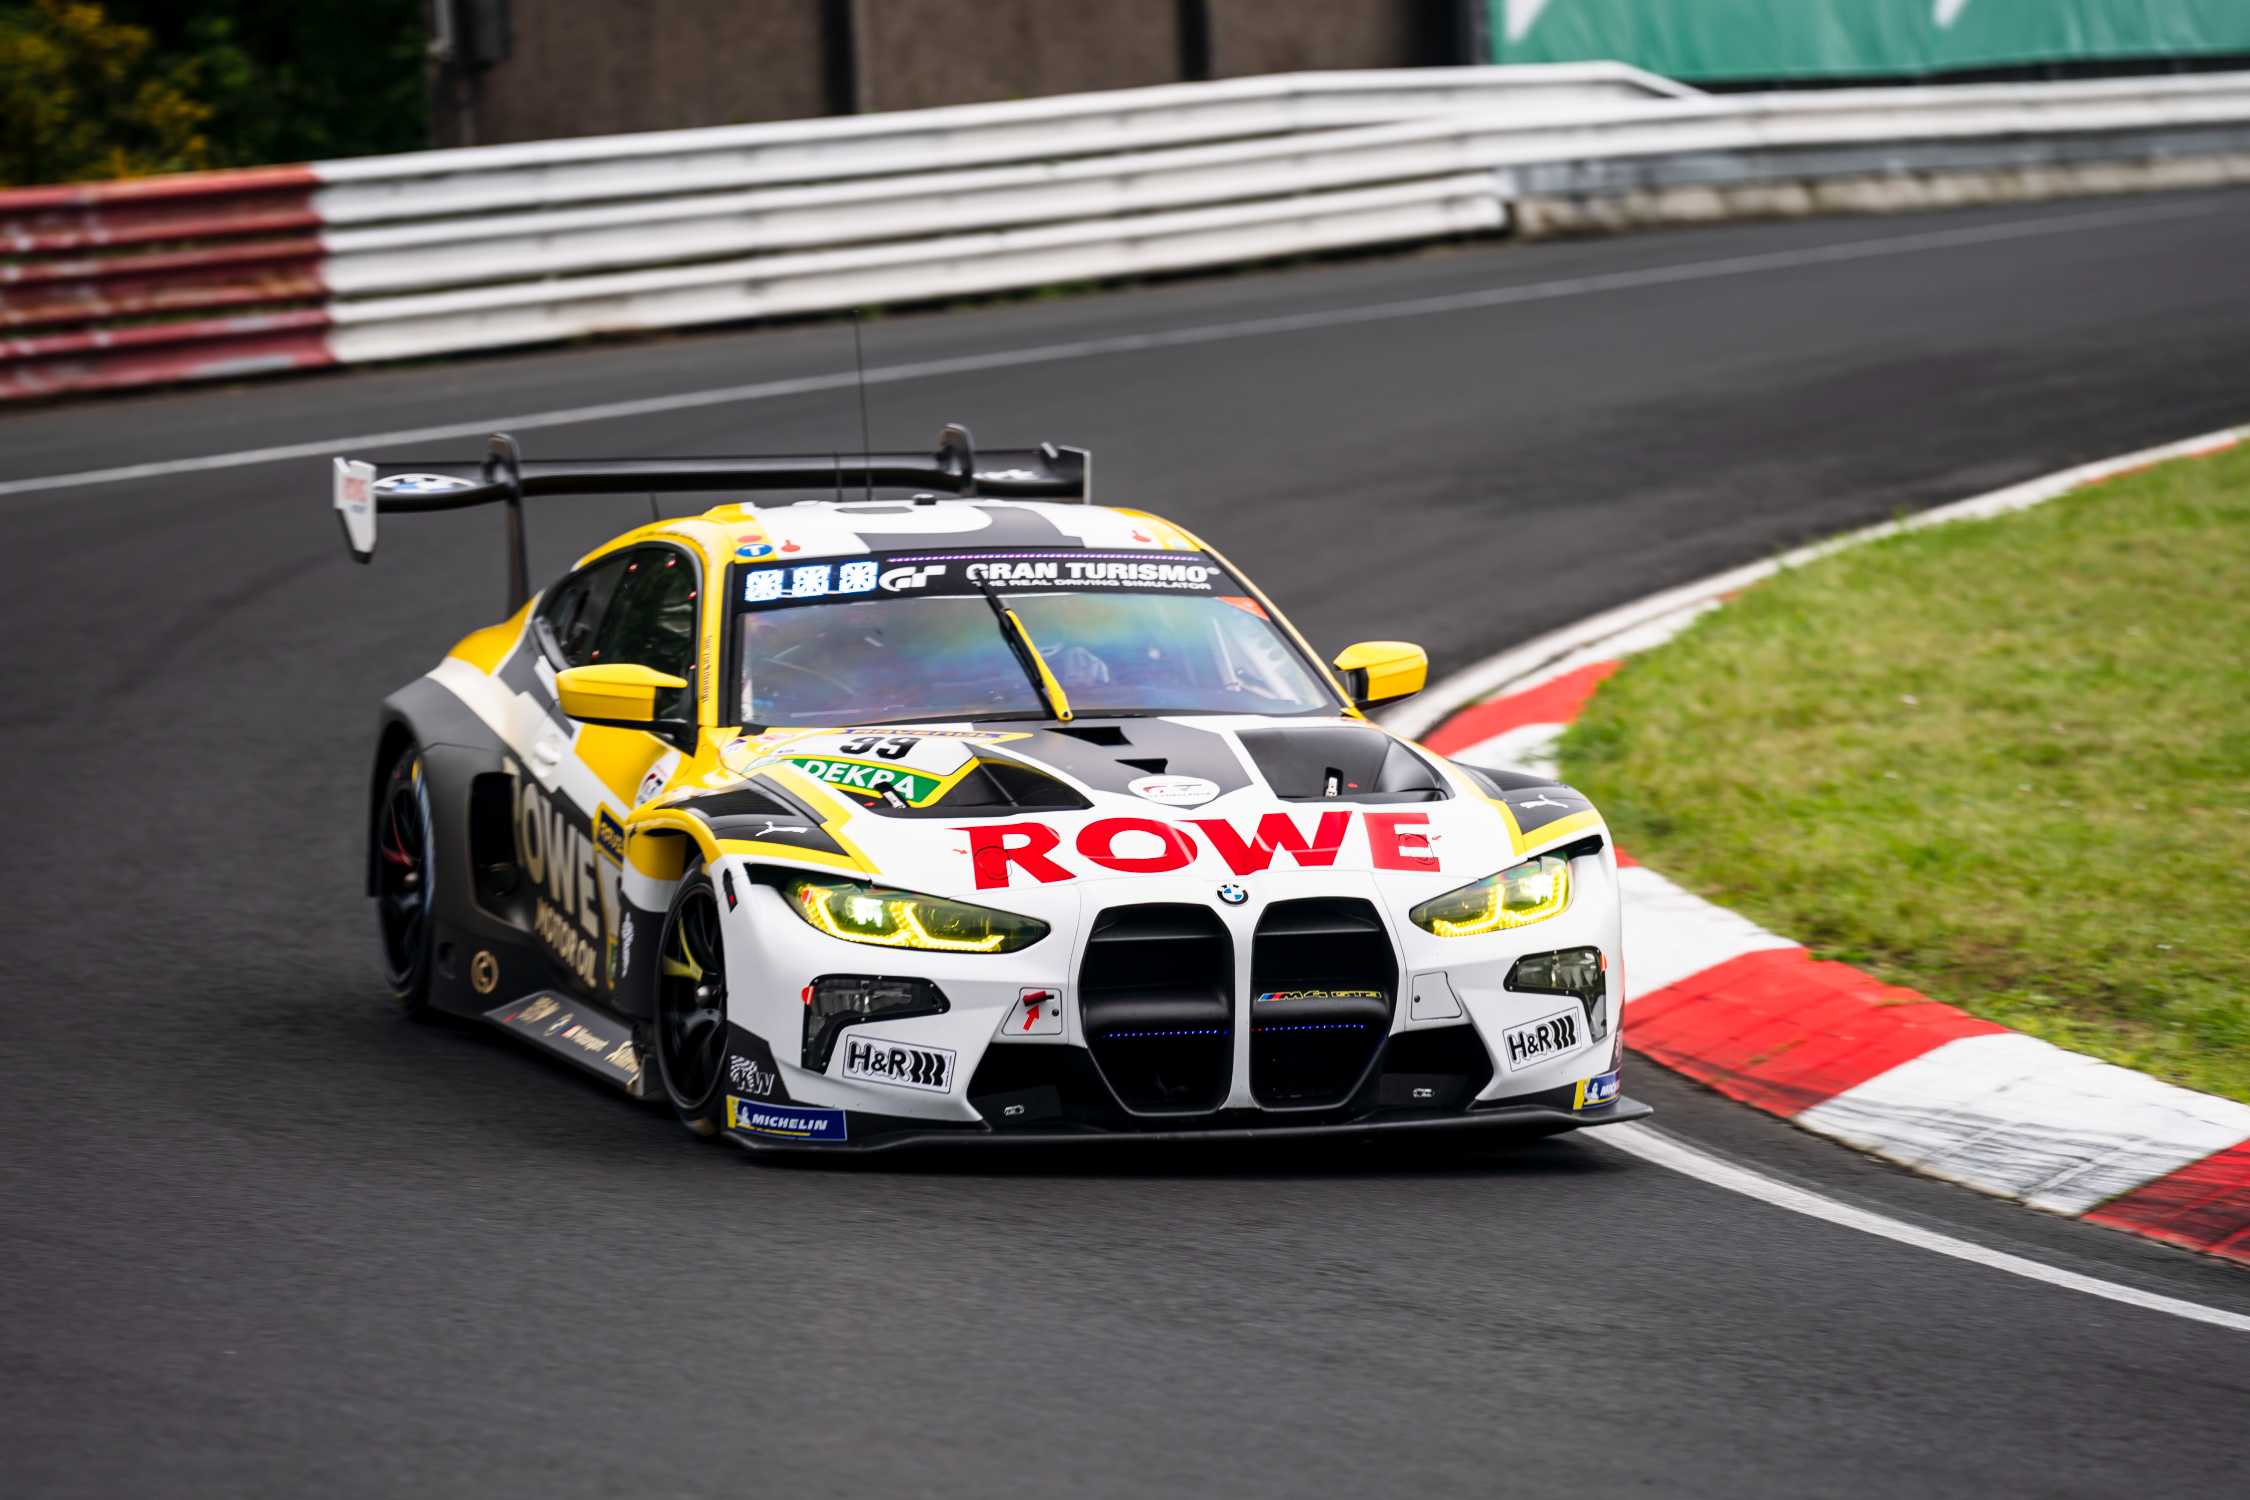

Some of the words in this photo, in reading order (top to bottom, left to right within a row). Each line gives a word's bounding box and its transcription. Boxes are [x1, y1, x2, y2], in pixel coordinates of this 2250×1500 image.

[966, 563, 1058, 581] GRAN
[1053, 578, 1120, 586] DRIVING
[1121, 580, 1211, 590] SIMULATOR
[839, 737, 921, 760] 99
[803, 761, 915, 799] DEKRA
[945, 811, 1440, 889] ROWE
[1507, 1024, 1553, 1062] H&R
[848, 1041, 907, 1078] H&R
[751, 1113, 829, 1131] MICHELIN
